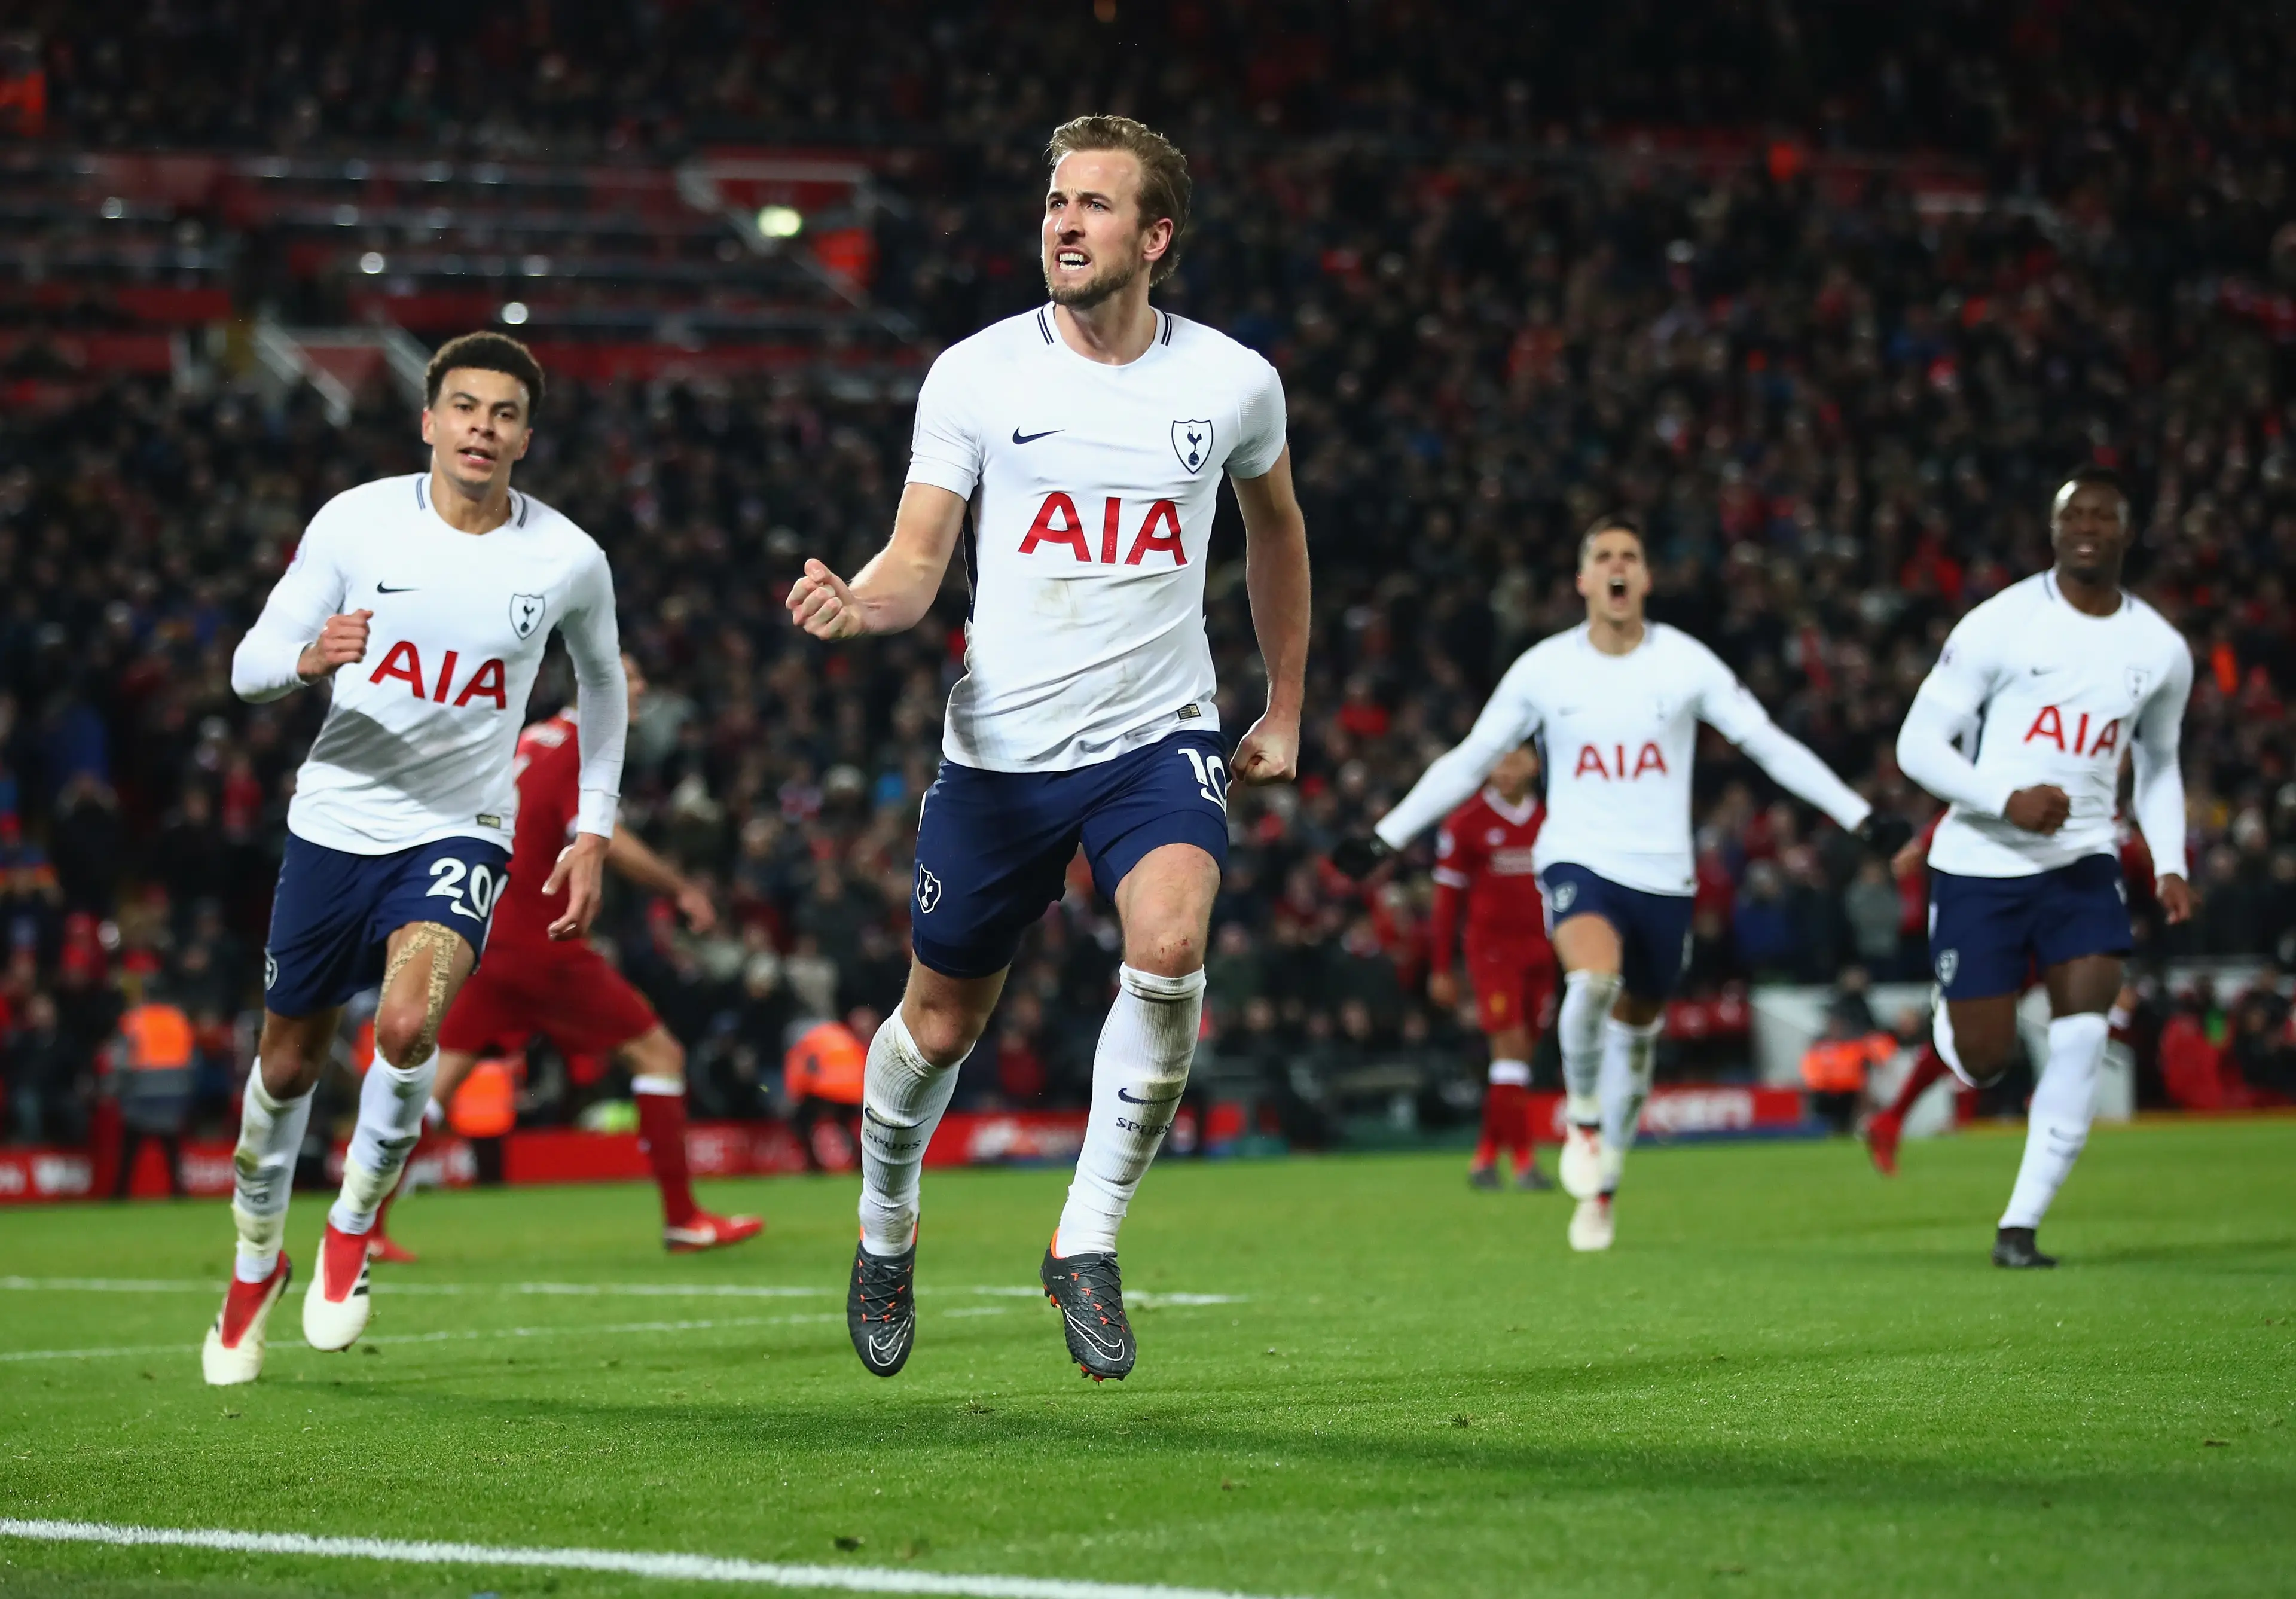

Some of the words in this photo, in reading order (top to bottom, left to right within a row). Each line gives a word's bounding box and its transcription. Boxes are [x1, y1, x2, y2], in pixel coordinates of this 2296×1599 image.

[1018, 492, 1187, 566] AIA
[369, 640, 506, 709] AIA
[1574, 743, 1668, 780] AIA
[2024, 706, 2120, 758] AIA
[1178, 748, 1227, 806] 10
[425, 857, 493, 918] 20
